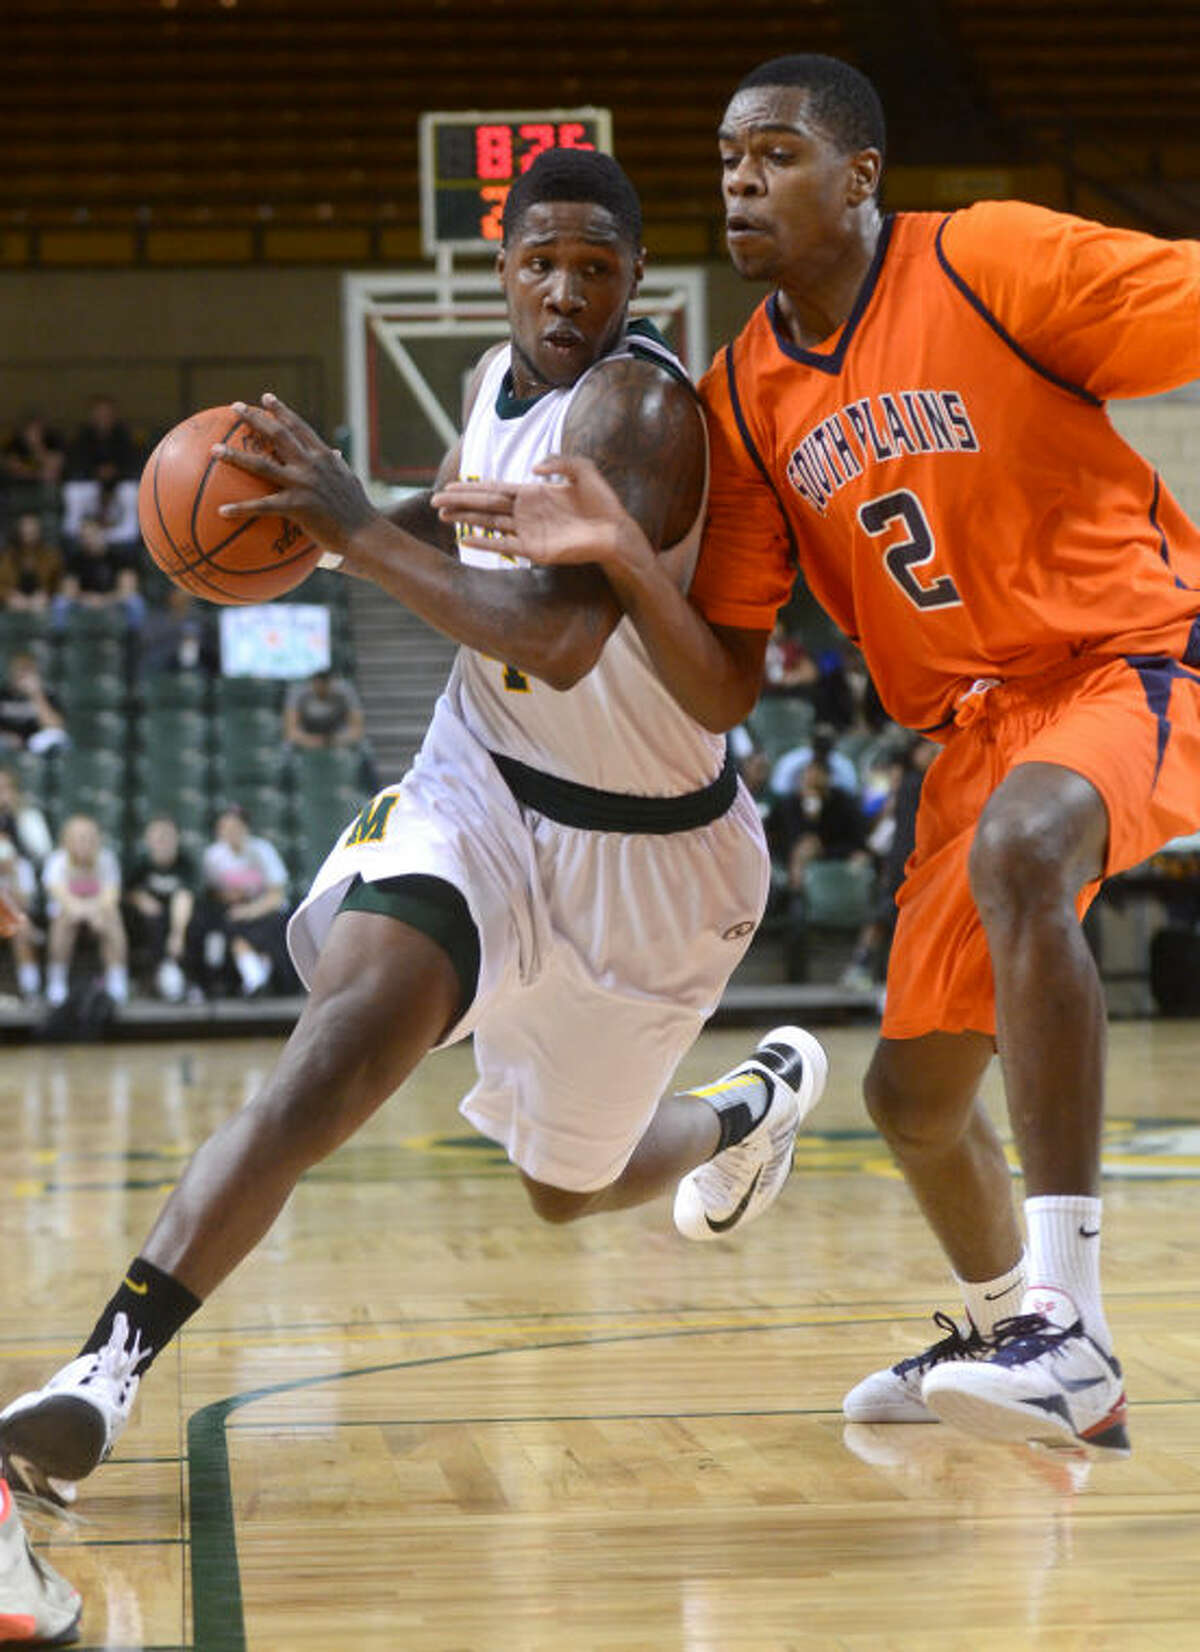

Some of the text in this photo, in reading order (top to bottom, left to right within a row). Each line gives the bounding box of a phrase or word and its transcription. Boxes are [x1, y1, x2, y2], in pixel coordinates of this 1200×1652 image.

[787, 390, 980, 517] SOUTH PLAINS
[856, 487, 964, 612] 2
[345, 792, 401, 848] M
